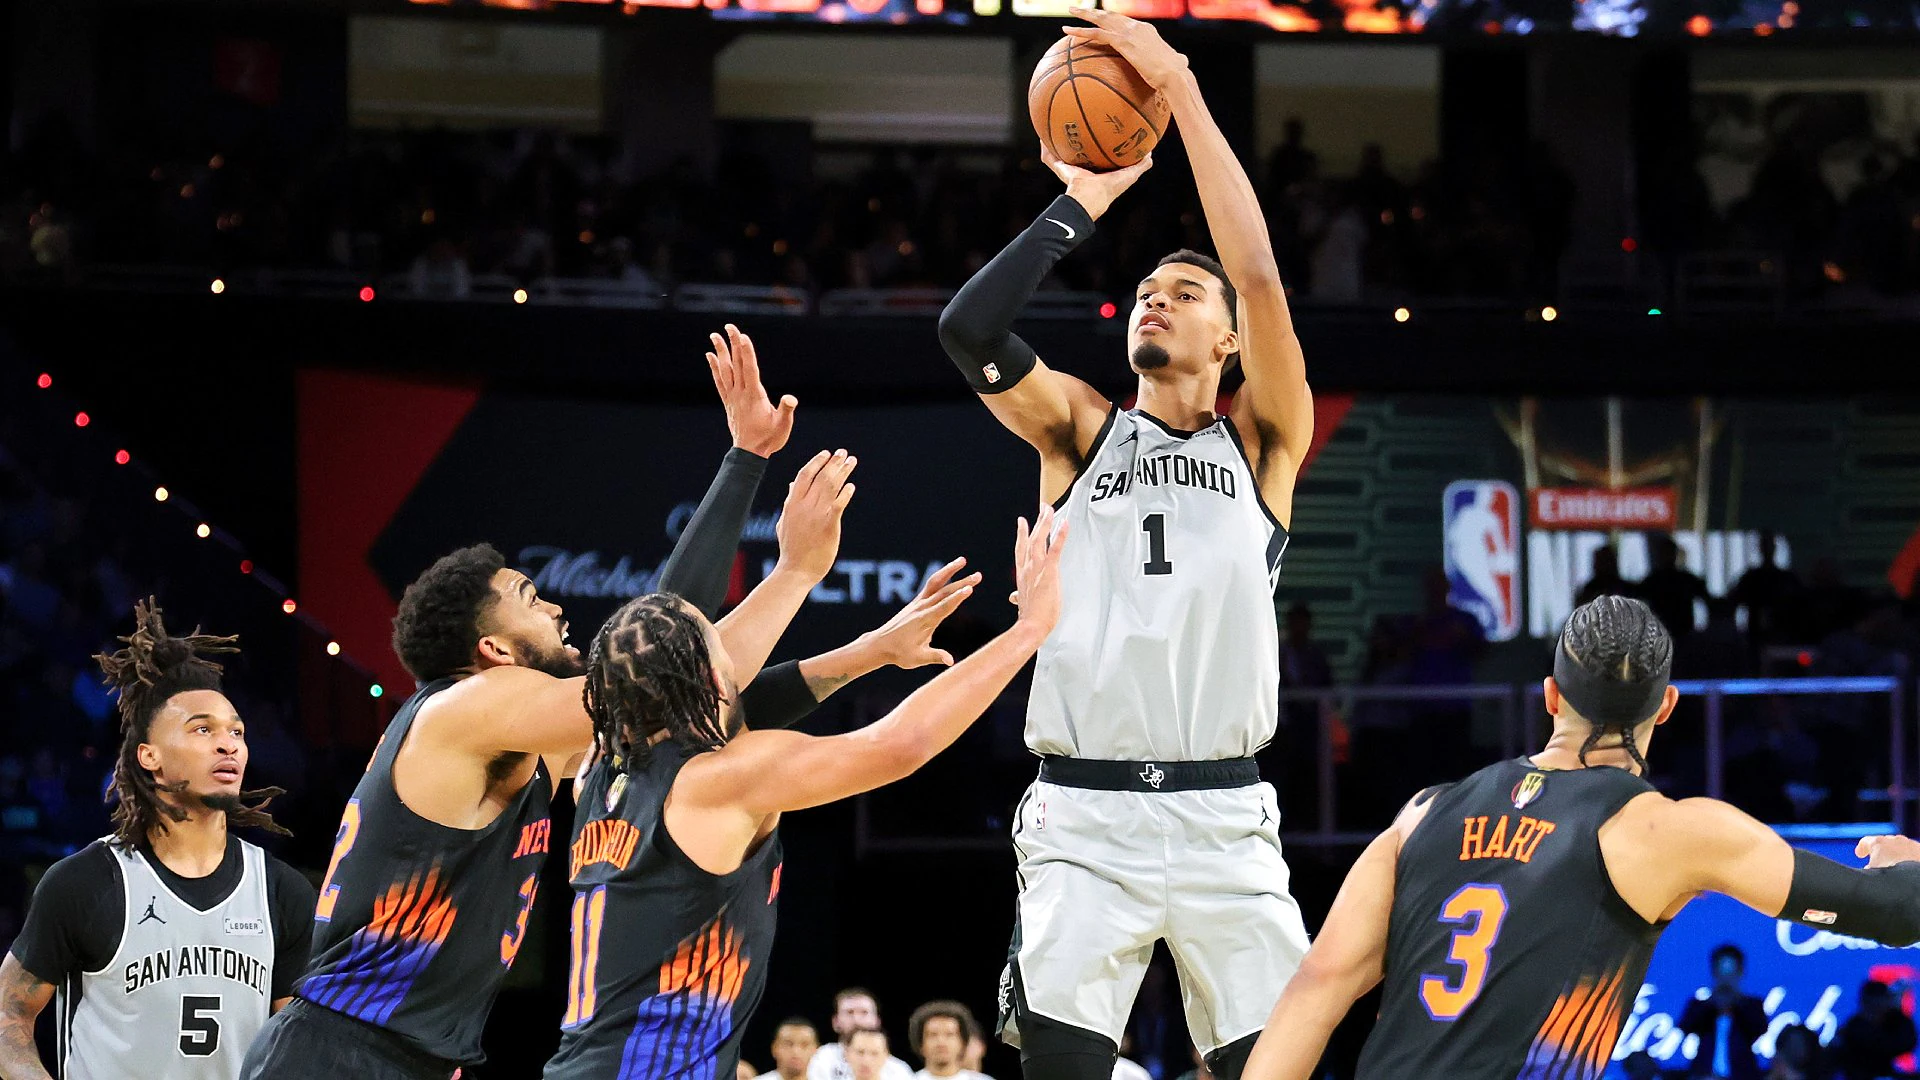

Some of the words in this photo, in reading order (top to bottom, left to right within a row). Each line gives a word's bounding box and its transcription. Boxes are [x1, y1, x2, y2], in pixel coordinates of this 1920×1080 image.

[1537, 489, 1671, 522] Emirates
[1141, 511, 1175, 576] 1
[762, 559, 948, 604] LTRA
[1459, 815, 1556, 863] HART
[229, 922, 259, 930] LEDGER
[501, 872, 541, 970] 3
[125, 949, 172, 994] SAN
[176, 945, 267, 997] ANTONIO
[560, 884, 607, 1029] 11
[1418, 882, 1509, 1021] 3
[178, 994, 222, 1058] 5
